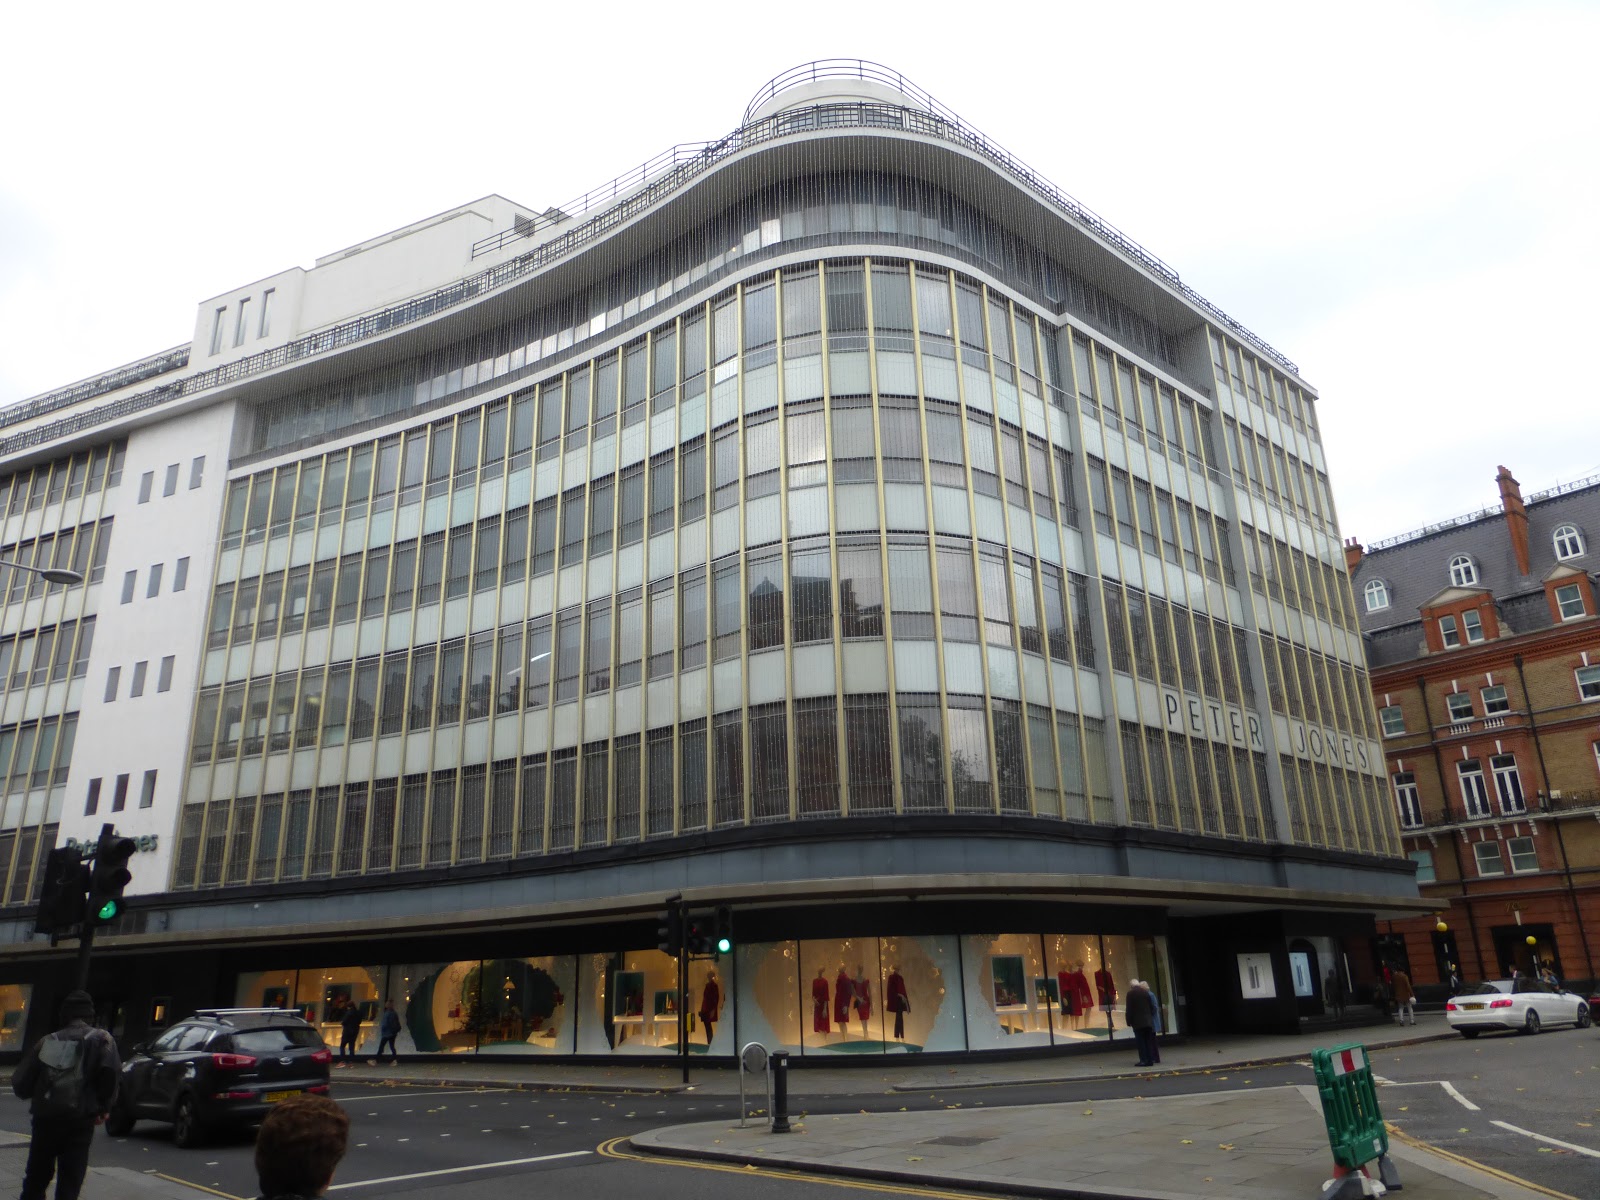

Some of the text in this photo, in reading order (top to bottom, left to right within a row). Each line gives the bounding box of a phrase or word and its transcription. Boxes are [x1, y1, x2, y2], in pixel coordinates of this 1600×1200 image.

[1165, 693, 1367, 769] PETER JONES
[66, 836, 100, 855] Pete
